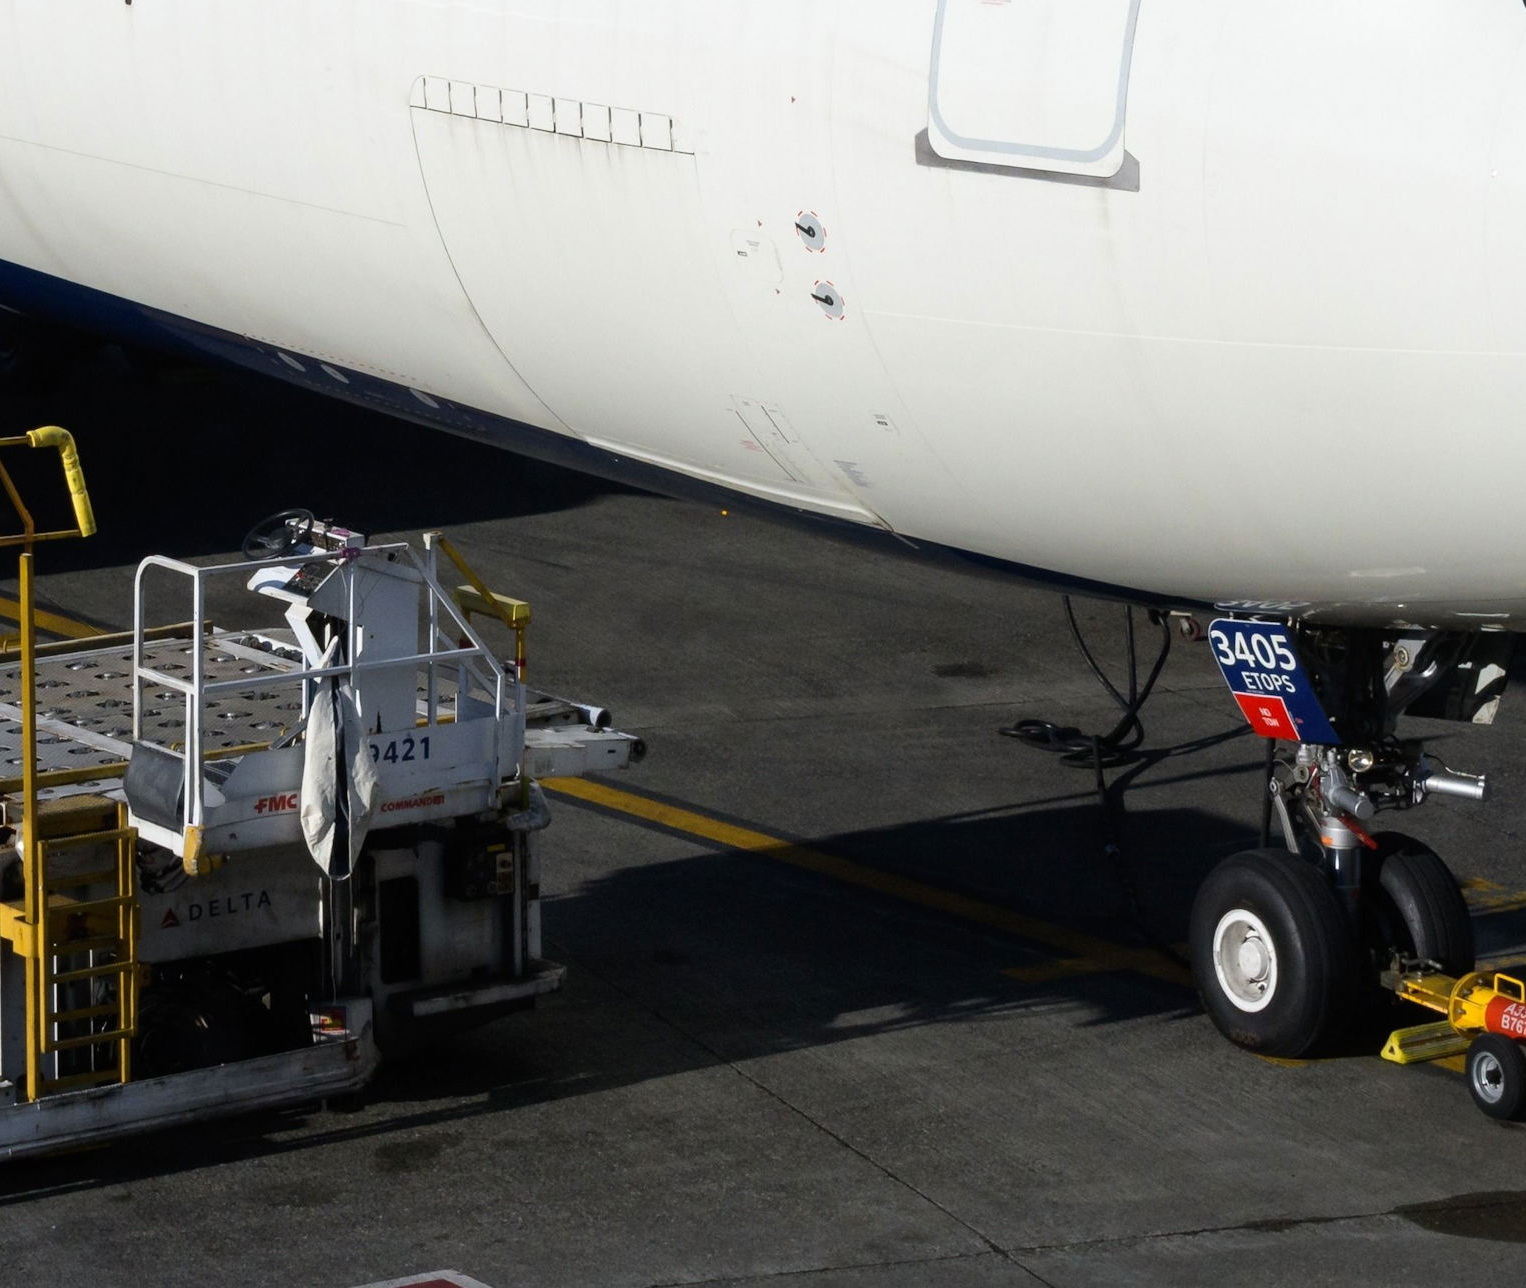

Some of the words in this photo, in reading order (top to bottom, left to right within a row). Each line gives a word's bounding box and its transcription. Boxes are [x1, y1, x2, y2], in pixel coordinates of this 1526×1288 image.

[1210, 630, 1296, 671] 3405
[1241, 671, 1296, 693] ETOPS
[1259, 707, 1272, 717] NO
[1261, 717, 1280, 727] TOW
[189, 890, 272, 921] DELTA
